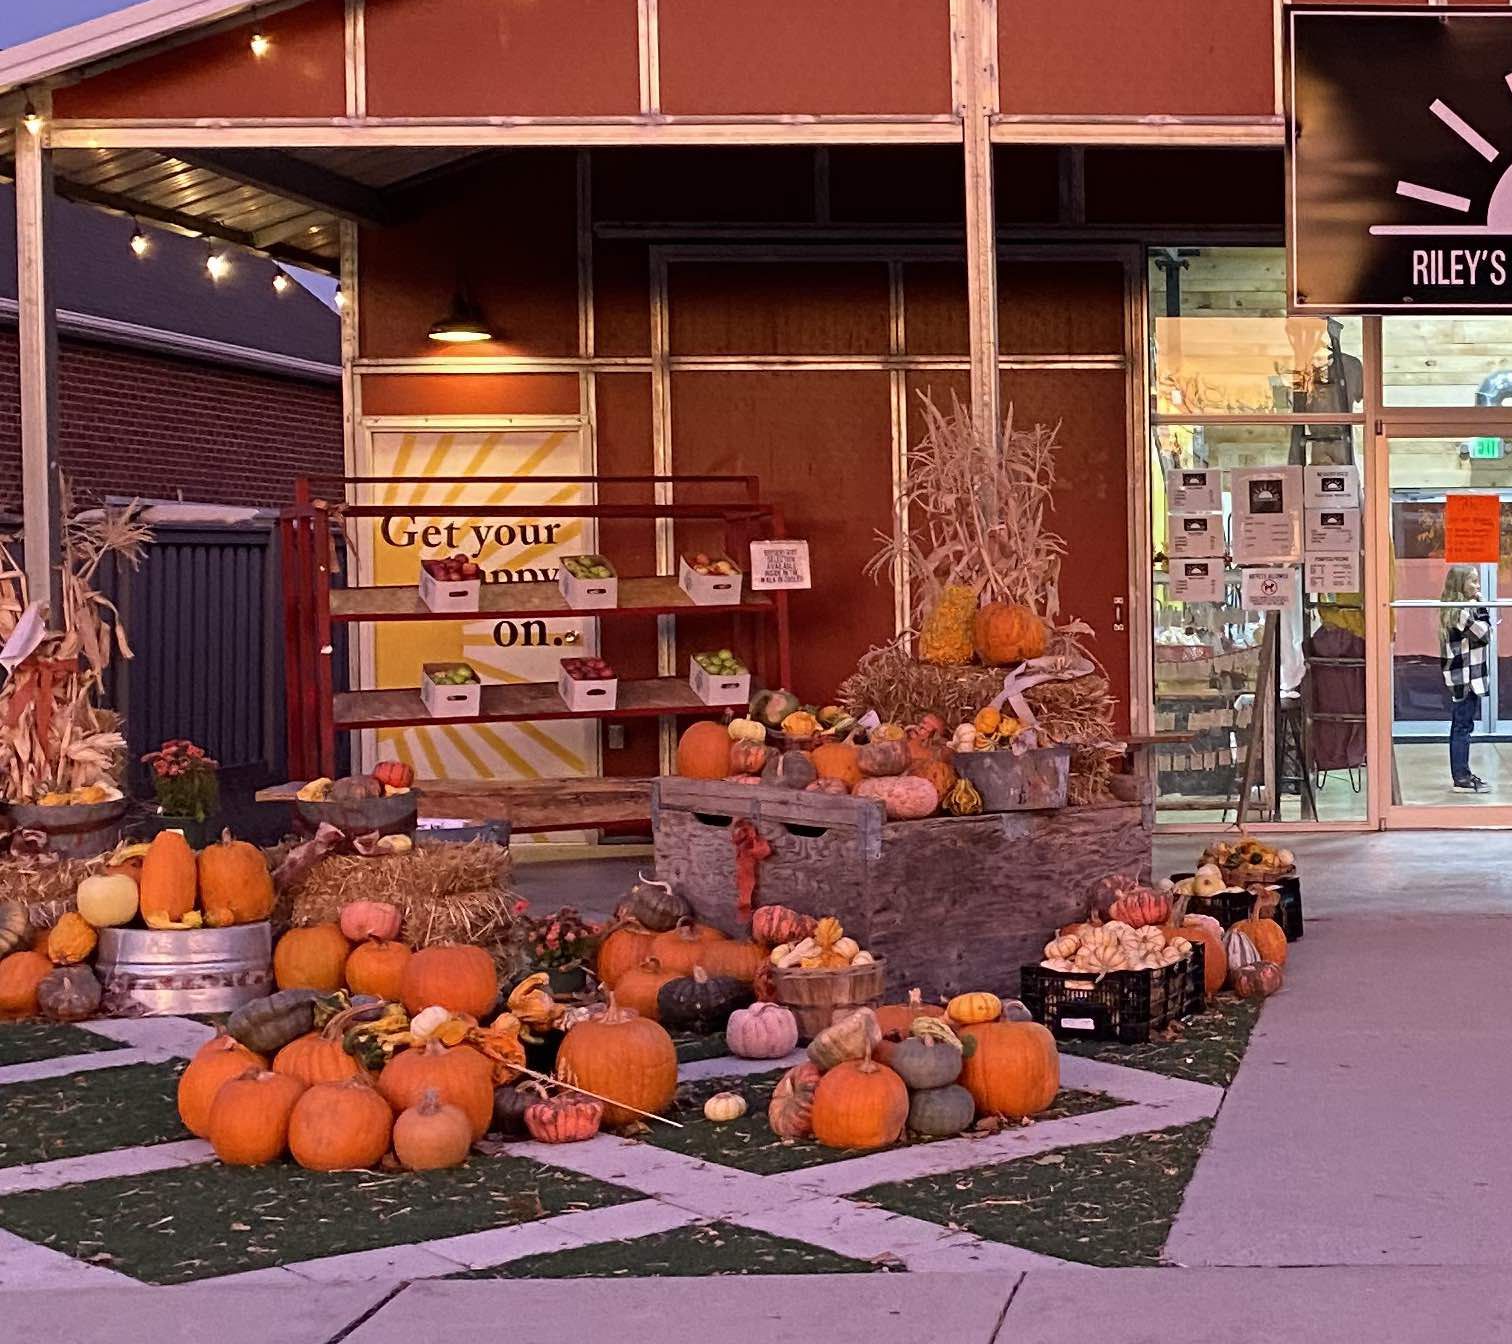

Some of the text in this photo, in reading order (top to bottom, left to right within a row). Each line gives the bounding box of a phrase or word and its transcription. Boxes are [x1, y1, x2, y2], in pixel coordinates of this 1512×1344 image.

[1412, 249, 1506, 286] RILEY'S
[381, 511, 561, 558] Get your
[493, 619, 563, 647] on.
